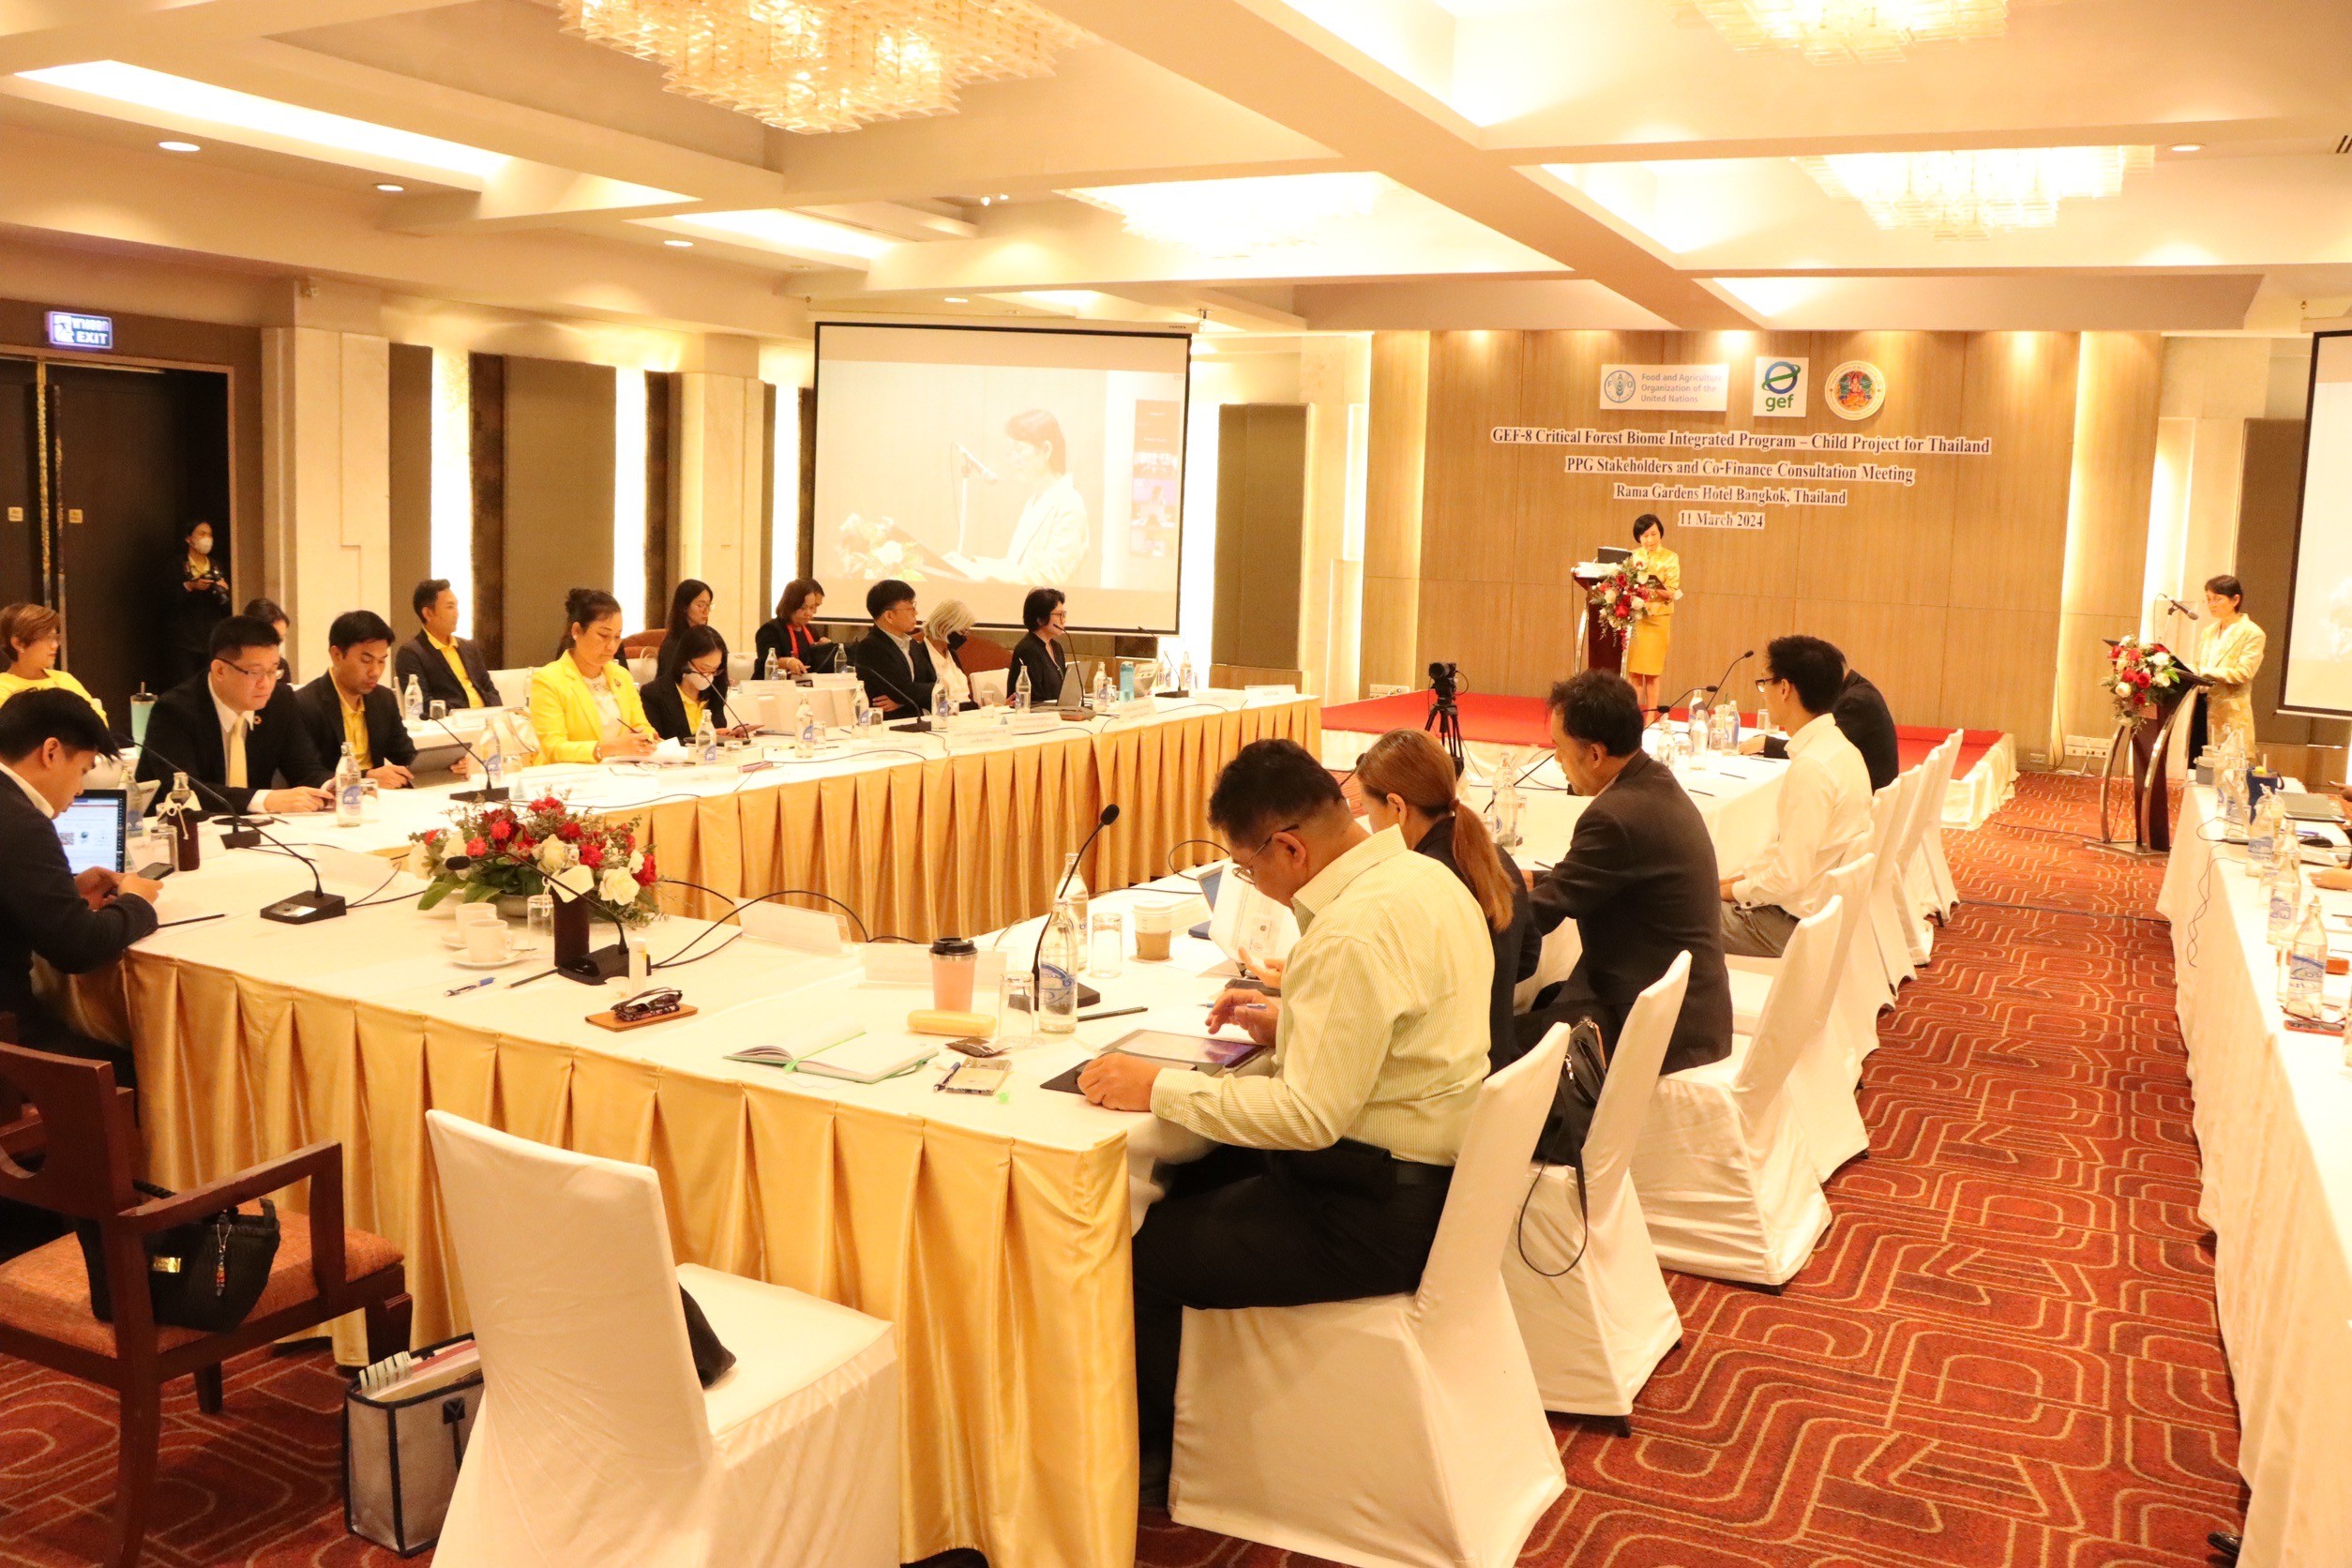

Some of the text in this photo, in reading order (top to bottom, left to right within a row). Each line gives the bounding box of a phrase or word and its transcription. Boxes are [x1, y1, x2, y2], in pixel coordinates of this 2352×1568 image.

[76, 331, 108, 344] EXIT
[1641, 373, 1723, 384] Food and Agriculture
[1641, 384, 1691, 393] Organization
[1693, 384, 1701, 392] of
[1668, 395, 1698, 403] Nations
[1765, 394, 1795, 412] gef
[1492, 428, 1532, 443] GEF-8
[1535, 430, 1581, 444] Critical
[1585, 430, 1623, 445] Forest
[1627, 430, 1666, 445] Biome
[1669, 431, 1735, 448] Integrated
[1739, 432, 1796, 450] Program
[1811, 434, 1847, 450] Child
[1852, 436, 1900, 454] Project
[1904, 437, 1924, 452] for
[1928, 437, 1990, 453] Thailand
[1566, 457, 1914, 483] PPG Stakeholders and Co-Finance Consultation Meeting
[1616, 484, 1847, 505] Rama Gardens Hotel Bangkok, Thailand
[1681, 512, 1763, 528] 11 March 2024
